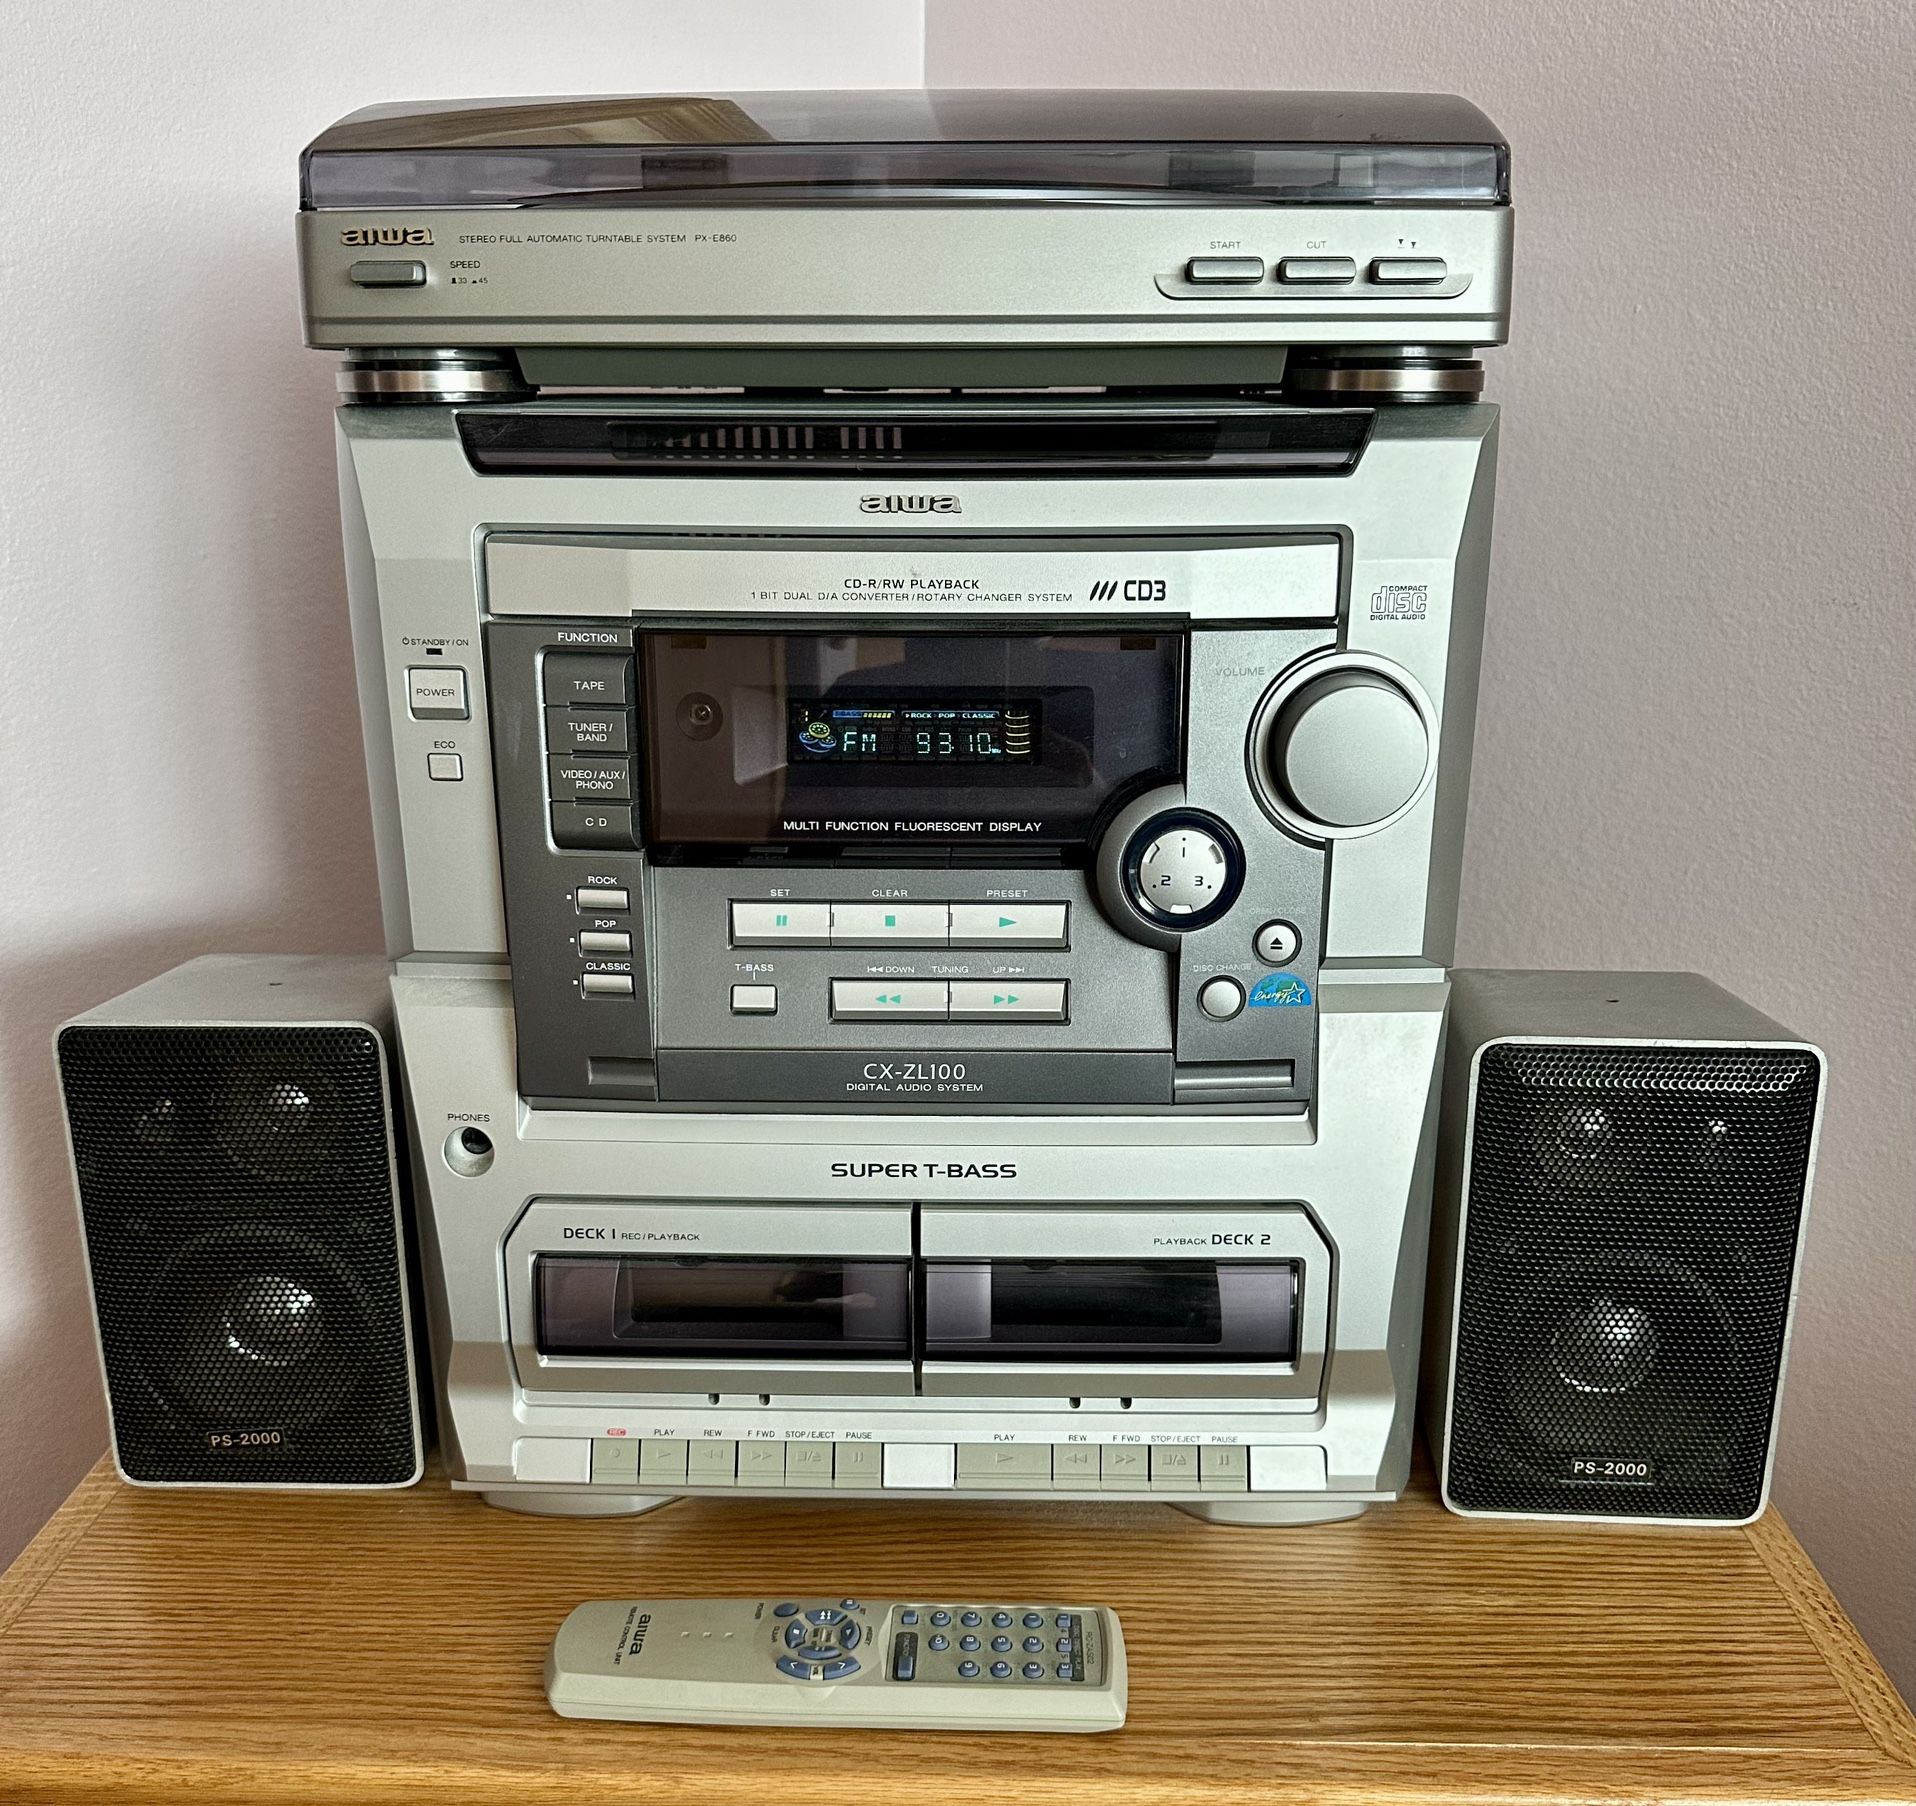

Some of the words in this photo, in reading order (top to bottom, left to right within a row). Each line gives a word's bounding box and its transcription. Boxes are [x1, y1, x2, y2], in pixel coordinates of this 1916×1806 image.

[341, 226, 434, 246] aiwa
[459, 235, 497, 243] STEREO
[500, 235, 523, 243] FULL
[527, 235, 583, 243] AUTOMATIC
[586, 235, 643, 243] TURNTABLE
[647, 234, 687, 243] SYSTEM
[695, 234, 737, 243] PX-E860
[1210, 241, 1241, 249] START
[1306, 241, 1327, 249] CUT
[450, 261, 481, 269] SPEED
[859, 494, 962, 513] aiwa
[844, 579, 905, 591] CD-R/RW
[910, 579, 980, 590] PLAYBACK
[1124, 580, 1166, 601] CD3
[751, 592, 757, 600] 1
[760, 592, 779, 601] BIT
[783, 592, 813, 601] DUAL
[818, 592, 839, 602] D/A
[967, 593, 1023, 602] CHANGER
[1028, 594, 1073, 602] SYSTEM
[1371, 586, 1428, 613] disc
[557, 632, 618, 643] FUNCTION
[1216, 667, 1265, 677] VOLUME
[574, 681, 605, 690] TAPE
[416, 688, 455, 697] POWER
[577, 733, 607, 742] BAND
[843, 731, 877, 752] FM
[434, 741, 456, 749] ECO
[575, 781, 614, 790] PHONO
[783, 821, 820, 831] MULTI
[825, 821, 889, 831] FUNCTION
[894, 822, 984, 832] FLUORESCENT
[989, 822, 1042, 832] DISPLAY
[587, 876, 618, 885] ROCK
[770, 889, 791, 897] SET
[872, 889, 908, 897] CLEAR
[986, 890, 1028, 898] PRESET
[595, 920, 616, 928] POP
[586, 962, 631, 971] CLASSIC
[735, 964, 774, 972] T-BASS
[931, 966, 969, 974] TUNING
[1193, 964, 1213, 972] DISC
[1216, 963, 1252, 971] CHANGE
[863, 1063, 966, 1080] CX-ZL100
[846, 1083, 890, 1091] DIGITAL
[896, 1084, 932, 1092] AUDIO
[937, 1084, 983, 1092] SYSTEM
[447, 1113, 490, 1122] PHONES
[831, 1163, 918, 1178] SUPER
[923, 1164, 1017, 1178] T-BASS
[563, 1227, 605, 1239] DECK
[1153, 1237, 1207, 1245] PLAYBACK
[1211, 1234, 1255, 1246] DECK
[1260, 1233, 1271, 1246] 2
[654, 1429, 675, 1437] PLAY
[756, 1430, 775, 1438] FWD
[785, 1431, 835, 1439] STOP/EJECT
[846, 1431, 872, 1439] PAUSE
[211, 1432, 280, 1447] PS-2000
[1068, 1434, 1087, 1442] REW
[1151, 1435, 1201, 1443] STOP/EJECT
[1574, 1461, 1647, 1476] PS-2000
